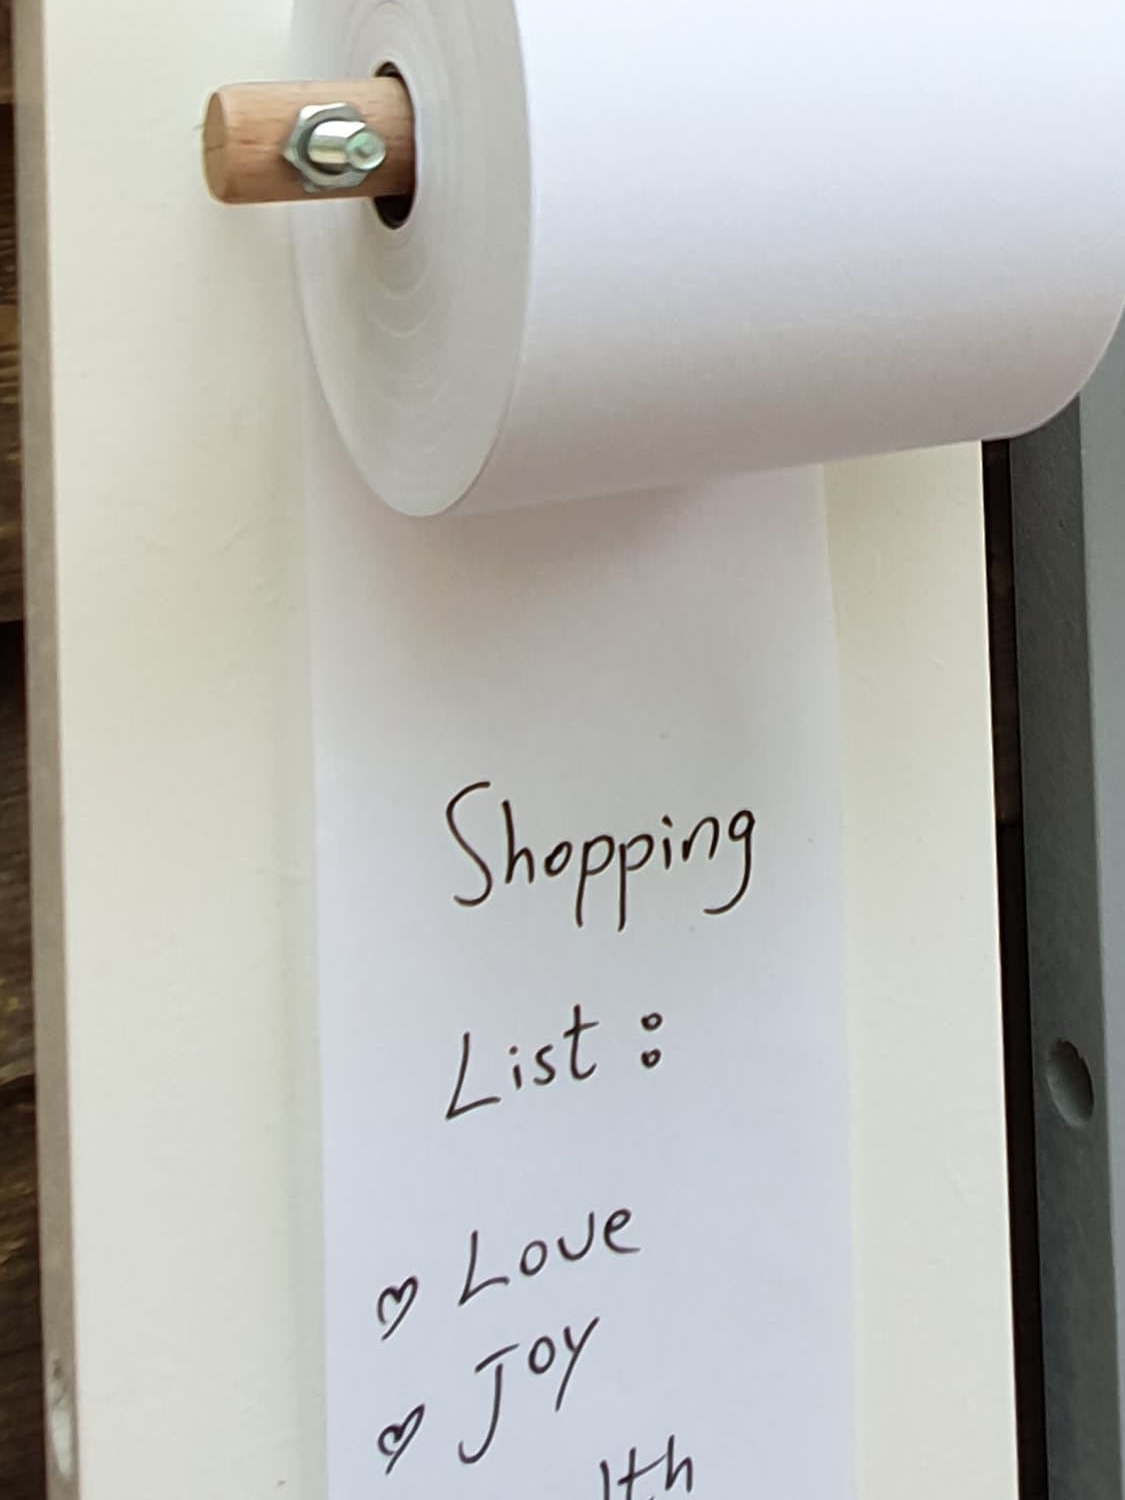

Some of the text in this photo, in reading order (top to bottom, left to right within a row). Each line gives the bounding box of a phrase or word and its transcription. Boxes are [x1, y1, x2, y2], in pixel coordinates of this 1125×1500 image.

[444, 780, 757, 932] Shopping
[457, 1207, 641, 1307] Love
[458, 1315, 600, 1464] Joy
